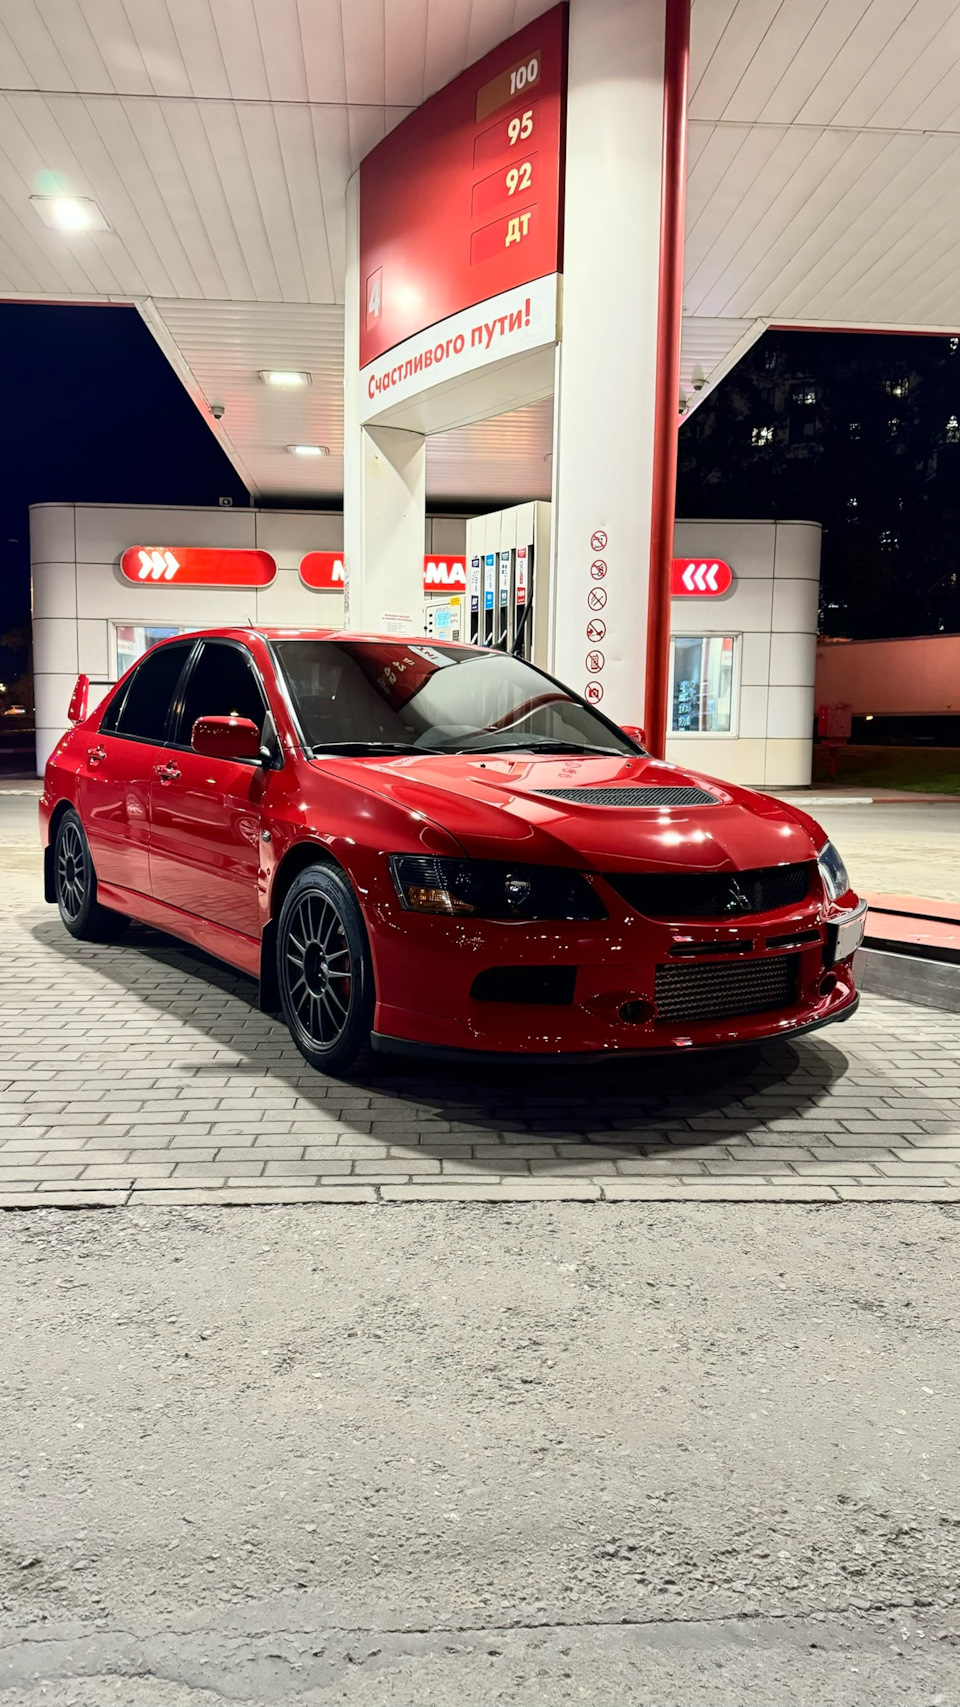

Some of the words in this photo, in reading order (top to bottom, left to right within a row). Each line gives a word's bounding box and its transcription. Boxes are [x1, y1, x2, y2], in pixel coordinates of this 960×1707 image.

[509, 58, 538, 95] 100
[507, 110, 533, 146] 95
[505, 162, 532, 197] 92
[505, 212, 531, 248] ДТ
[368, 280, 381, 318] 4
[368, 336, 465, 399] Счастливого
[470, 298, 531, 350] пути!
